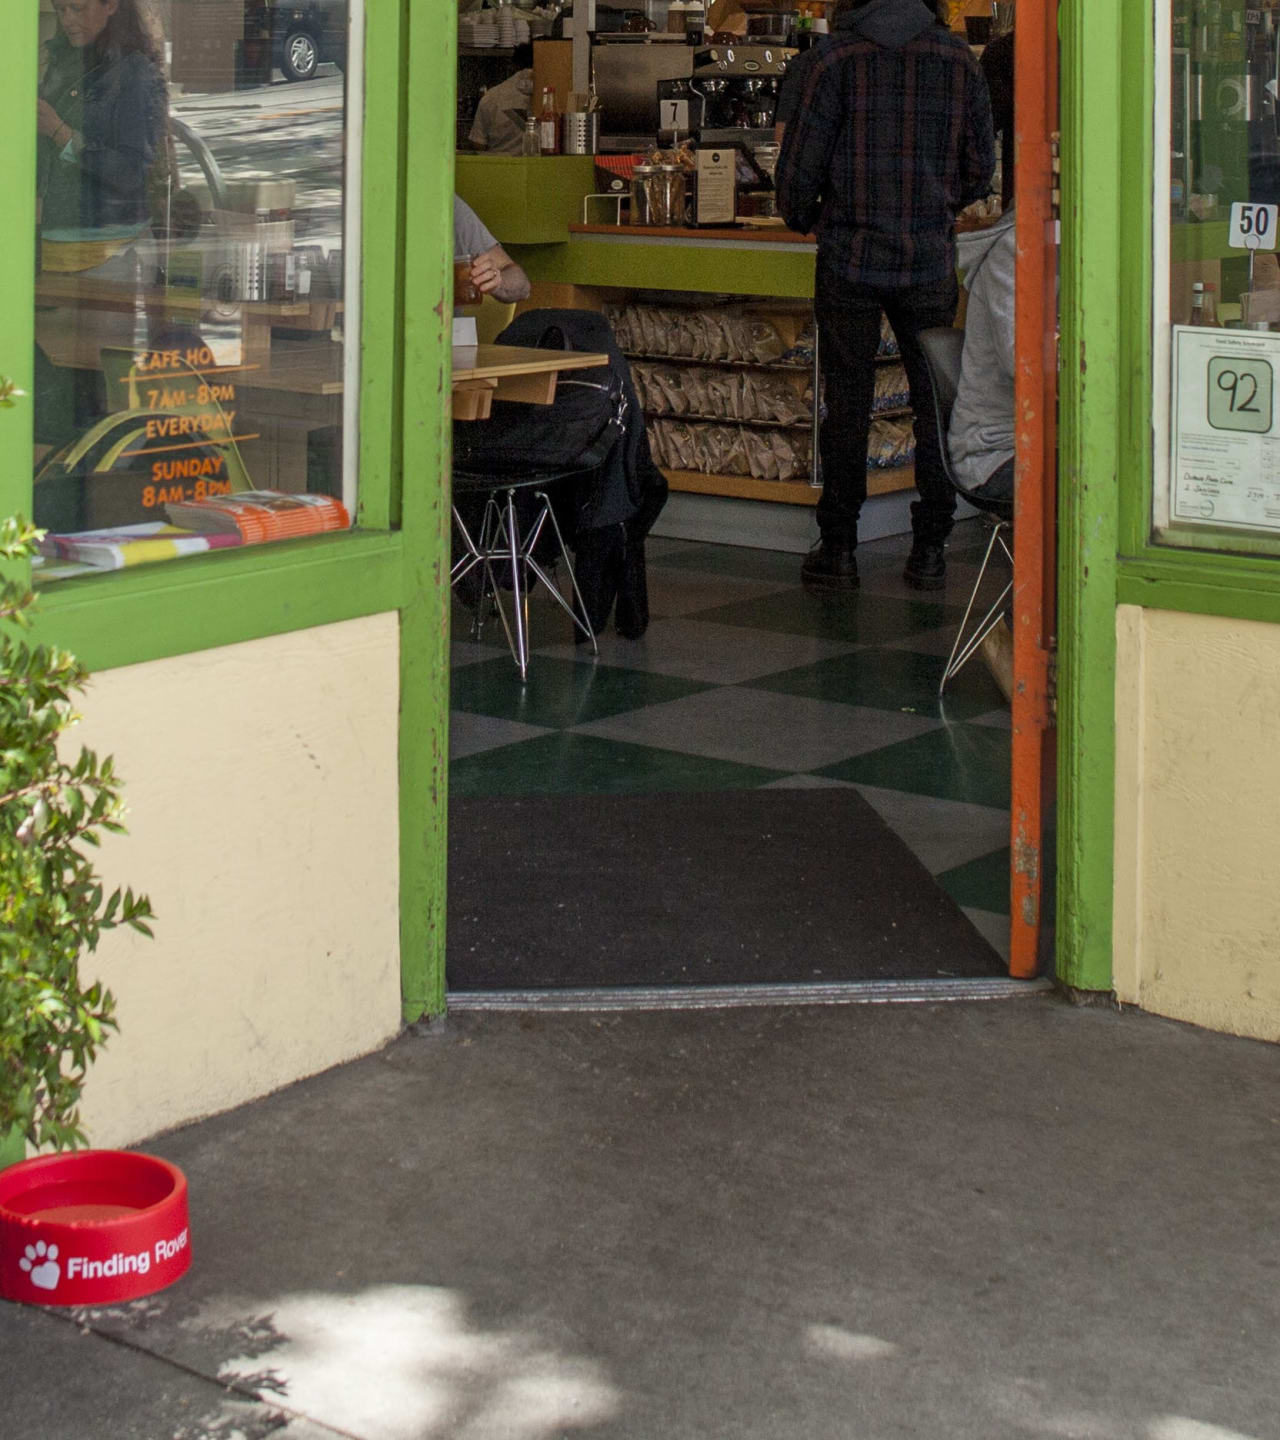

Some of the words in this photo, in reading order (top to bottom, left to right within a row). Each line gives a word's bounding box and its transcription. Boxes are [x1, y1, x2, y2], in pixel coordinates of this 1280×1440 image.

[671, 103, 679, 122] 7
[1240, 205, 1268, 236] 50
[1217, 370, 1261, 412] 92
[146, 411, 236, 439] EVERYDAY
[152, 456, 224, 481] SUNDAY
[67, 1250, 150, 1280] Finding
[155, 1228, 188, 1263] Rover
